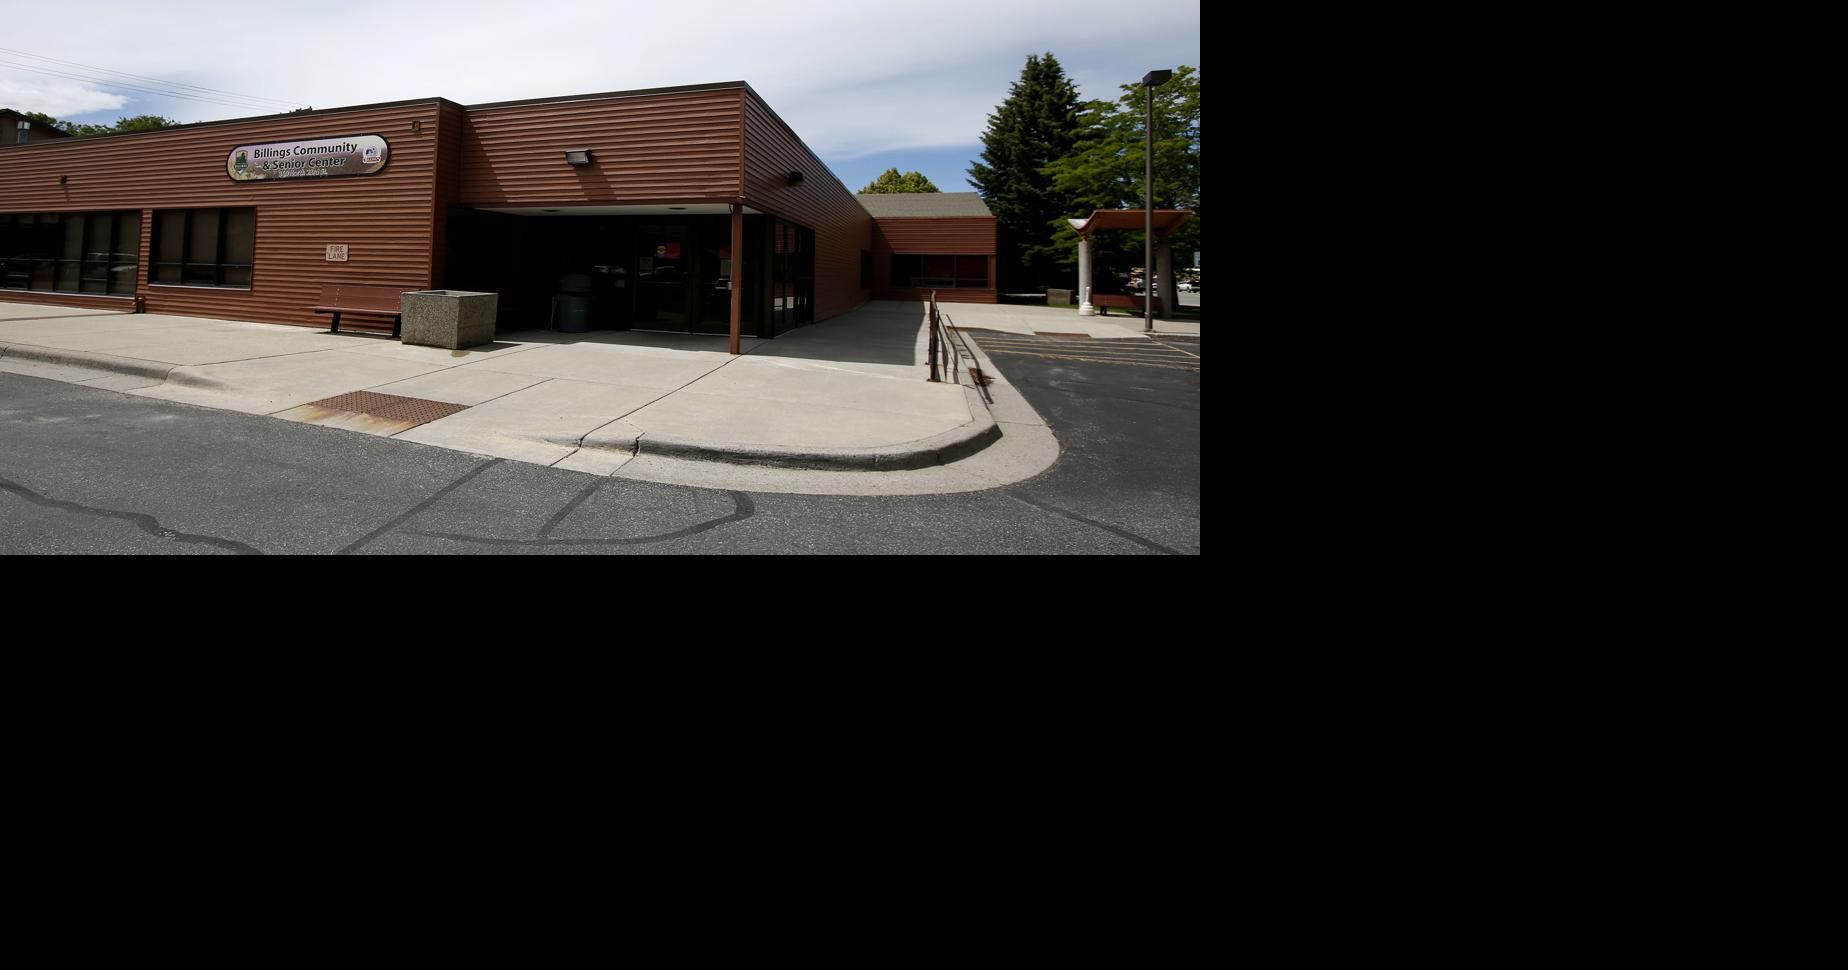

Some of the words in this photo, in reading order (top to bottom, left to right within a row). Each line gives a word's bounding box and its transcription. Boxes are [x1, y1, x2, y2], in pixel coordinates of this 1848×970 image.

[254, 148, 290, 159] Billings
[293, 142, 358, 156] Community
[263, 161, 270, 170] &
[272, 159, 305, 170] Senior
[308, 157, 345, 168] Center
[328, 252, 345, 260] LANE
